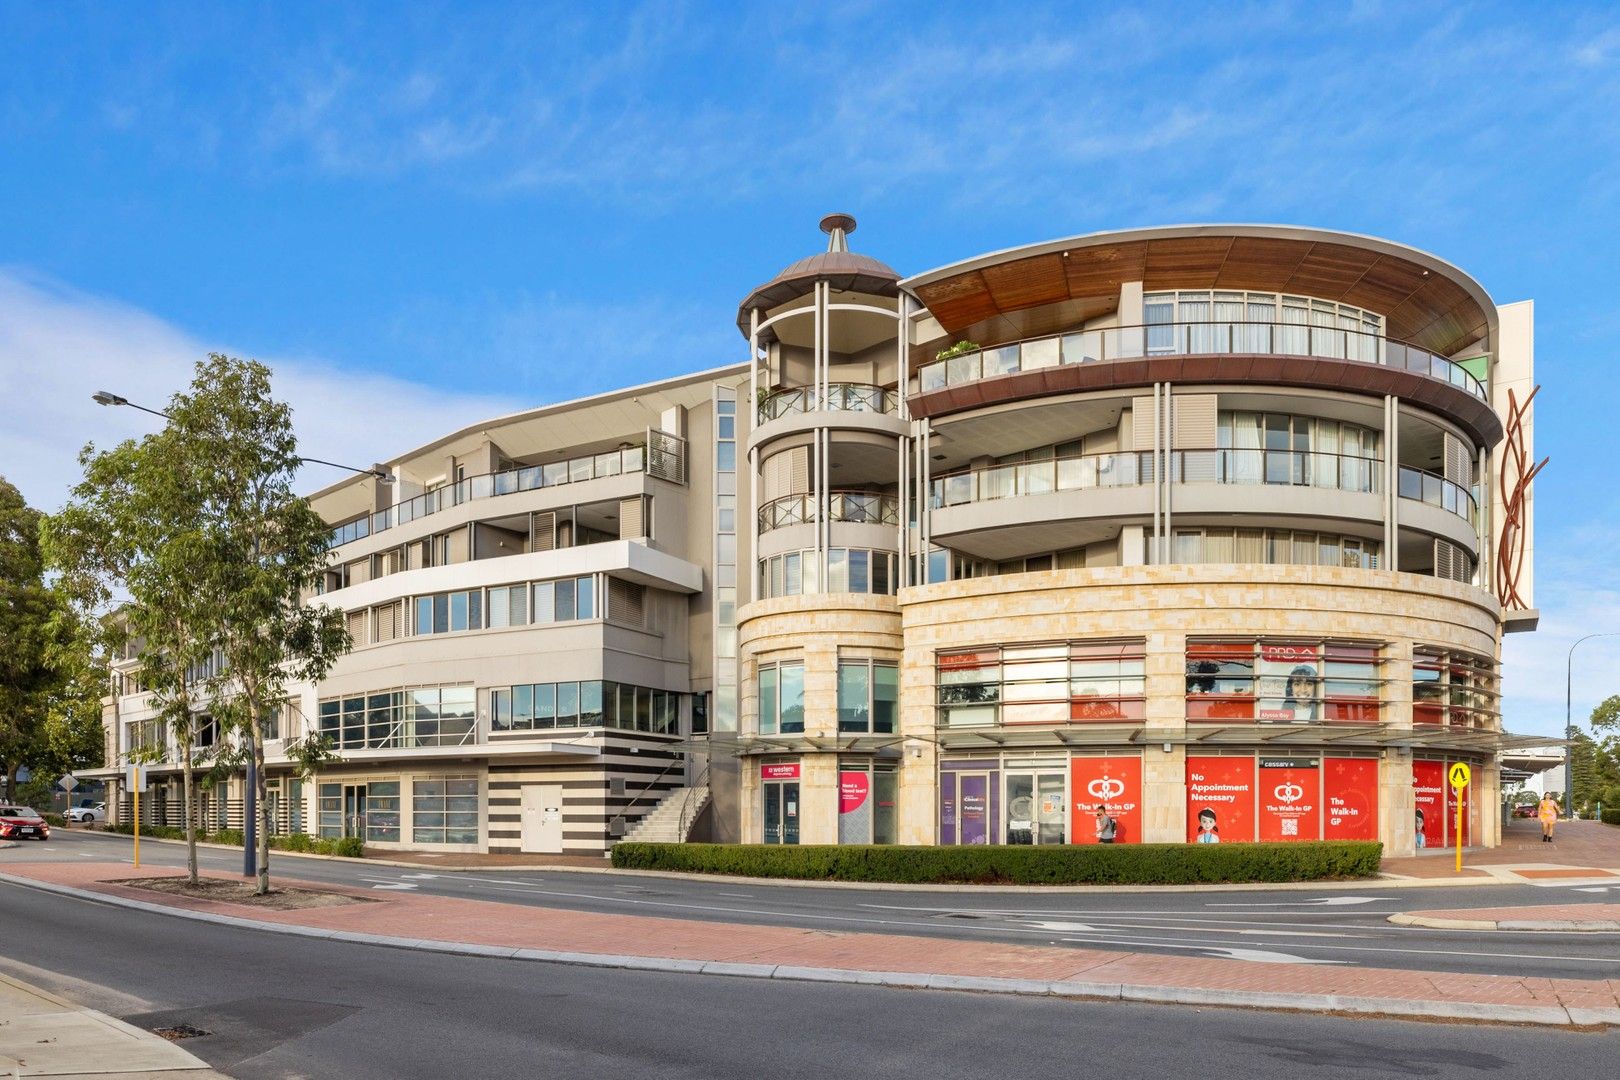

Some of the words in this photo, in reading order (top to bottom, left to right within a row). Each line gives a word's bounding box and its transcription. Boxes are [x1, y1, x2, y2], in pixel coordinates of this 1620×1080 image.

[1191, 773, 1205, 781] No
[1191, 783, 1249, 793] Appointment
[1191, 793, 1236, 803] Necessary
[1330, 797, 1345, 805] The
[1330, 818, 1342, 826] GP
